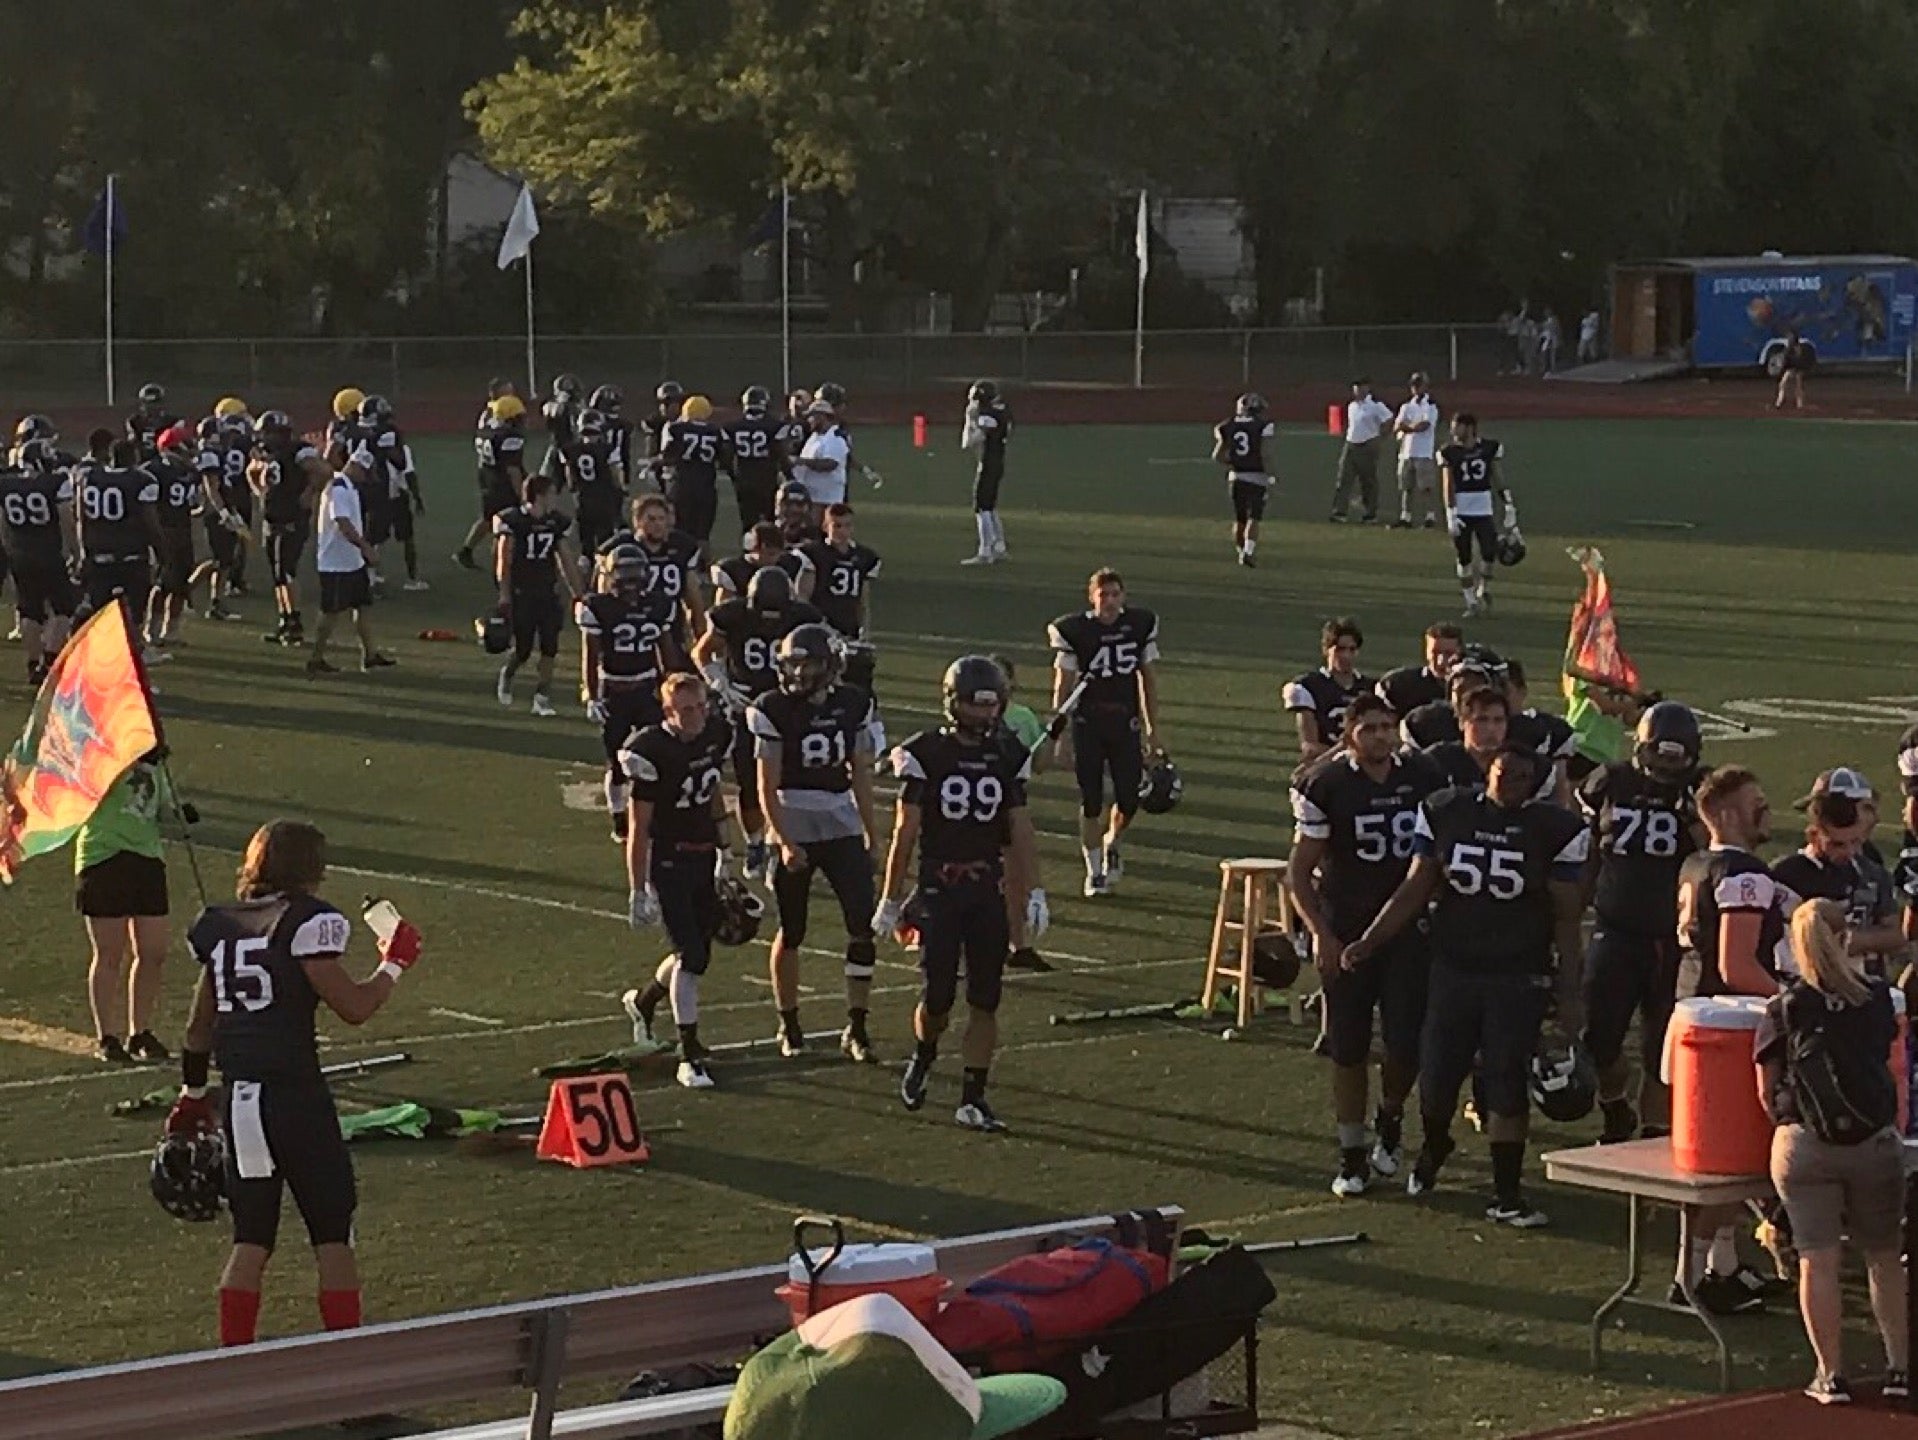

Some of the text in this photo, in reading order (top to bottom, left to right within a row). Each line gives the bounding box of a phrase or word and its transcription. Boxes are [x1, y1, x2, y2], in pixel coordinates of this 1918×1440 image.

[682, 433, 717, 462] 75
[735, 430, 769, 458] 52
[1233, 431, 1249, 456] 3
[578, 454, 596, 482] 8
[1461, 459, 1487, 481] 13
[5, 492, 50, 525] 69
[84, 485, 124, 520] 90
[526, 533, 554, 559] 17
[648, 564, 681, 596] 79
[830, 567, 860, 596] 31
[612, 623, 661, 652] 22
[1089, 642, 1138, 678] 45
[802, 730, 846, 767] 81
[941, 775, 1002, 822] 89
[1355, 811, 1416, 861] 58
[1612, 806, 1678, 856] 78
[1449, 843, 1524, 900] 55
[211, 936, 273, 1012] 15
[567, 1081, 641, 1157] 50
